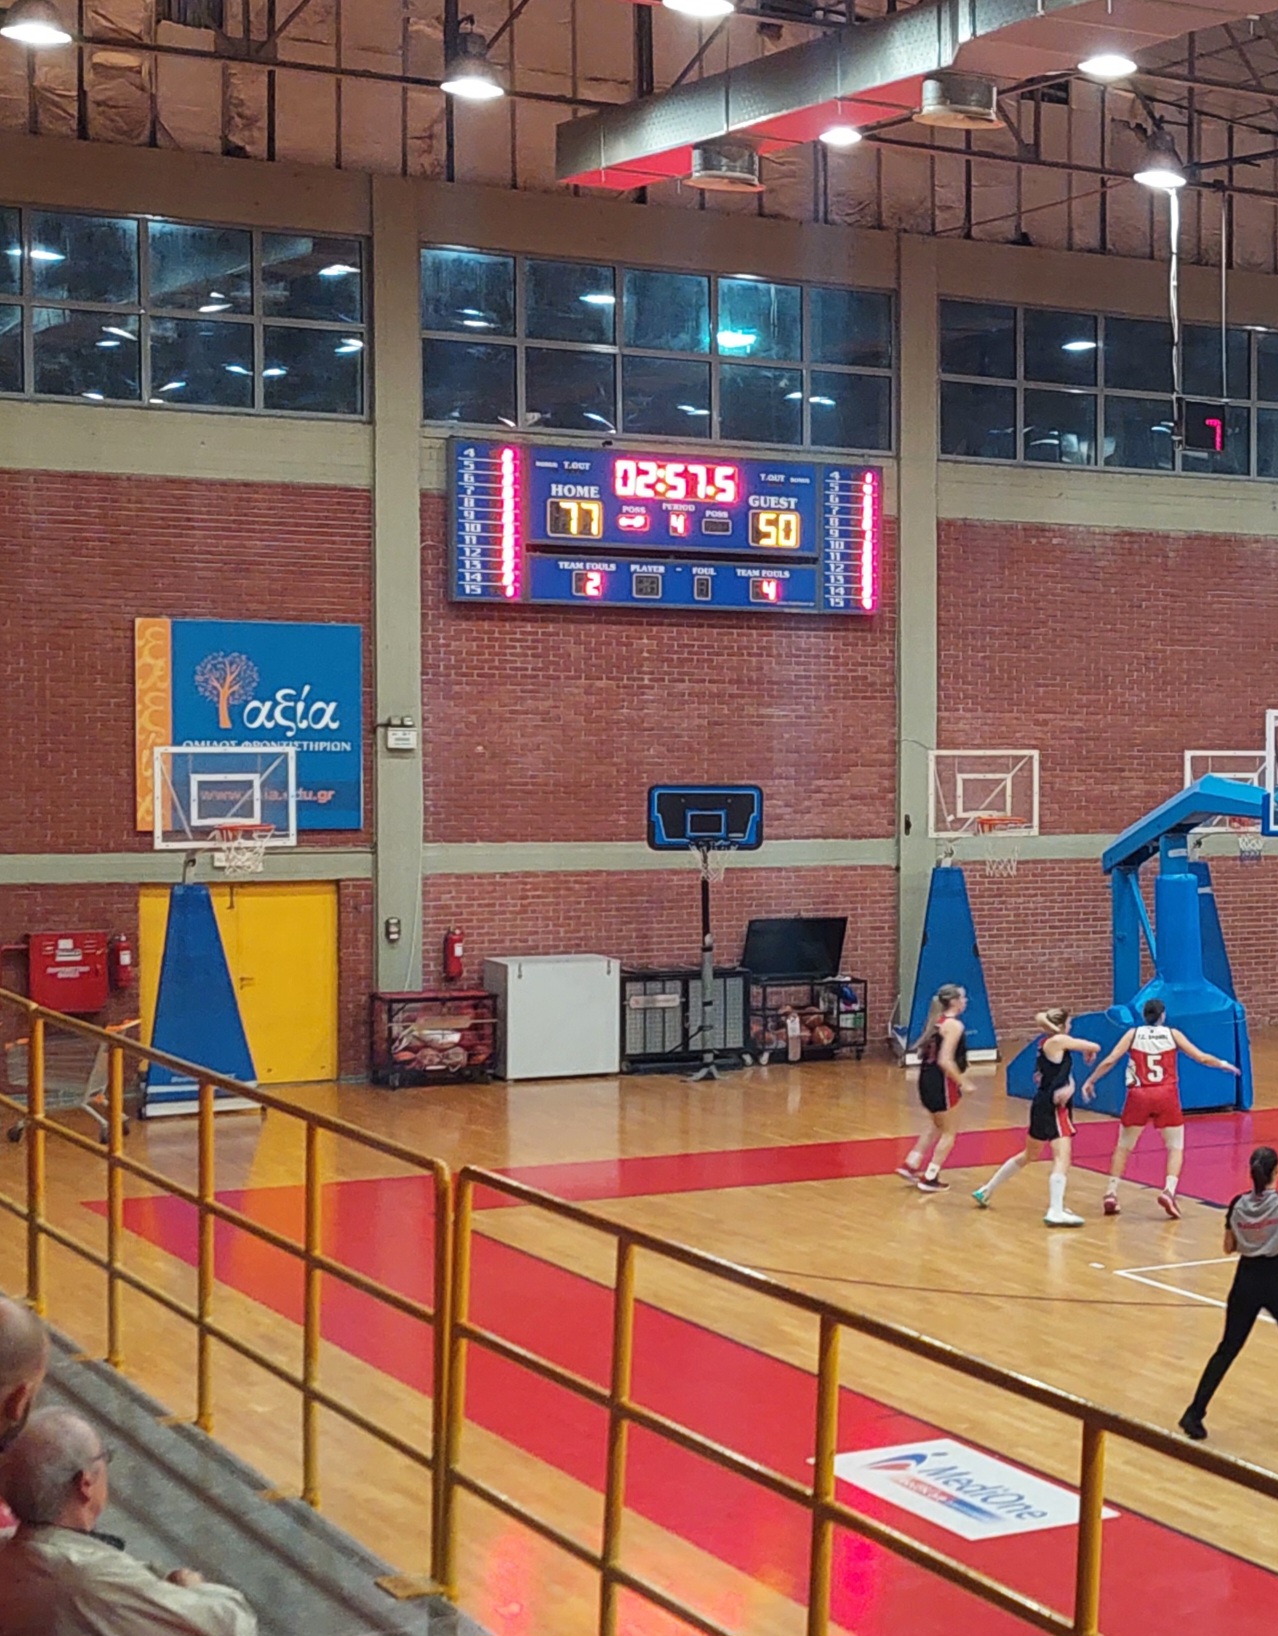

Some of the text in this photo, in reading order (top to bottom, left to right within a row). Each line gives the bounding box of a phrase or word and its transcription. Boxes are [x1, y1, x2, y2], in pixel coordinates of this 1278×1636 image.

[1205, 418, 1222, 452] 7
[463, 448, 475, 458] 4
[463, 461, 475, 471] 5
[563, 460, 591, 470] T.OUT
[463, 473, 475, 483] 6
[760, 473, 785, 482] T.OUT
[829, 471, 840, 480] 4
[463, 486, 475, 496] 7
[550, 483, 600, 498] HOME
[829, 483, 840, 492] 5
[463, 498, 475, 508] 8
[748, 495, 798, 509] GUEST
[829, 494, 840, 503] 6
[622, 505, 646, 514] POSS
[662, 503, 696, 512] PERIOD
[829, 506, 840, 515] 7
[463, 510, 475, 520] 9
[559, 501, 600, 535] 77
[705, 510, 729, 519] POSS
[670, 513, 684, 534] 4
[829, 518, 840, 527] 8
[464, 523, 482, 533] 10
[758, 512, 797, 546] 50
[829, 529, 840, 538] 9
[464, 535, 477, 545] 11
[829, 540, 844, 549] 10
[464, 548, 482, 558] 12
[829, 552, 841, 561] 11
[464, 560, 481, 570] 13
[558, 561, 617, 572] TEAM FOULS
[630, 564, 665, 573] PLAYER
[692, 566, 717, 575] FOUL
[829, 563, 844, 572] 12
[464, 573, 482, 583] 14
[736, 568, 790, 578] TEAM FOULS
[586, 571, 602, 596] 2
[829, 575, 844, 584] 13
[464, 585, 482, 595] 15
[762, 579, 777, 600] 4
[829, 586, 845, 595] 14
[829, 598, 844, 607] 15
[243, 684, 340, 738] αξία
[1147, 1055, 1164, 1082] 5
